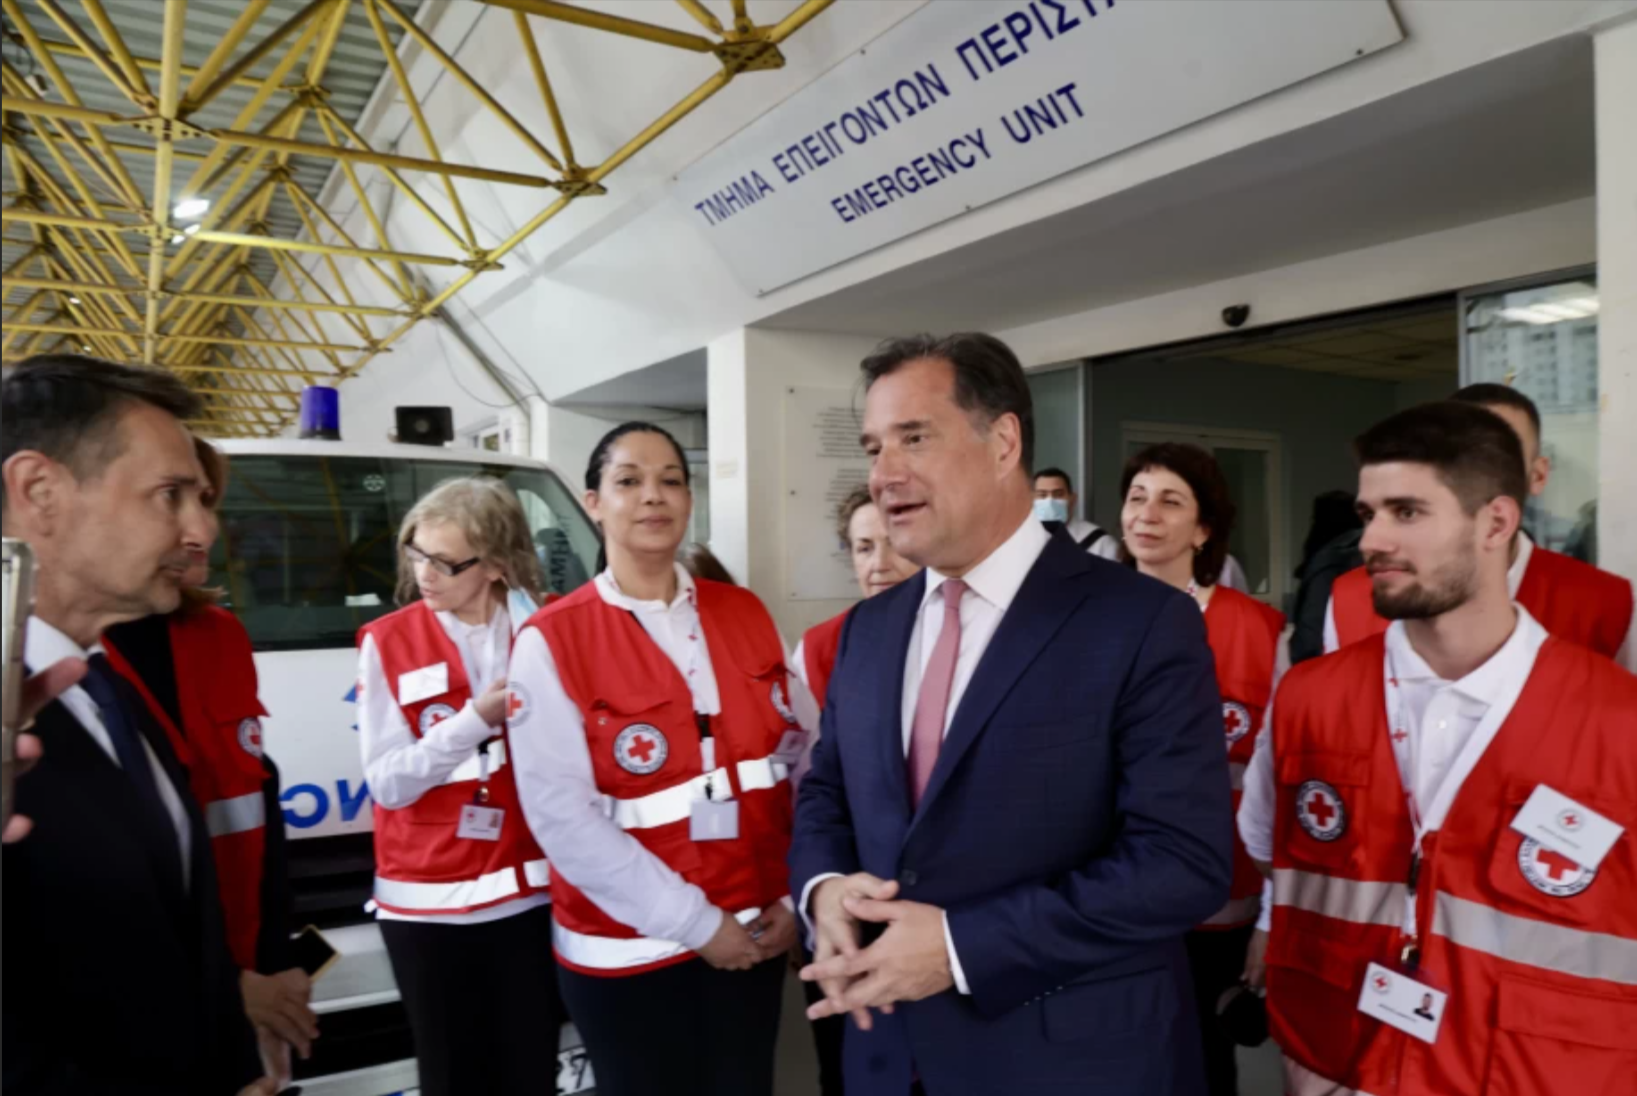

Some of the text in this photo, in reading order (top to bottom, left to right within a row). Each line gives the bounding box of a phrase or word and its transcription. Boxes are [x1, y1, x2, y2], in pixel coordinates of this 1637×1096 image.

[694, 0, 1115, 226] ΤΜΗΜΑ ΕΠΕΙΓΟΝΤΩΝ ΠΕΡΙΣ
[830, 82, 1086, 223] EMERGENCY UNIT
